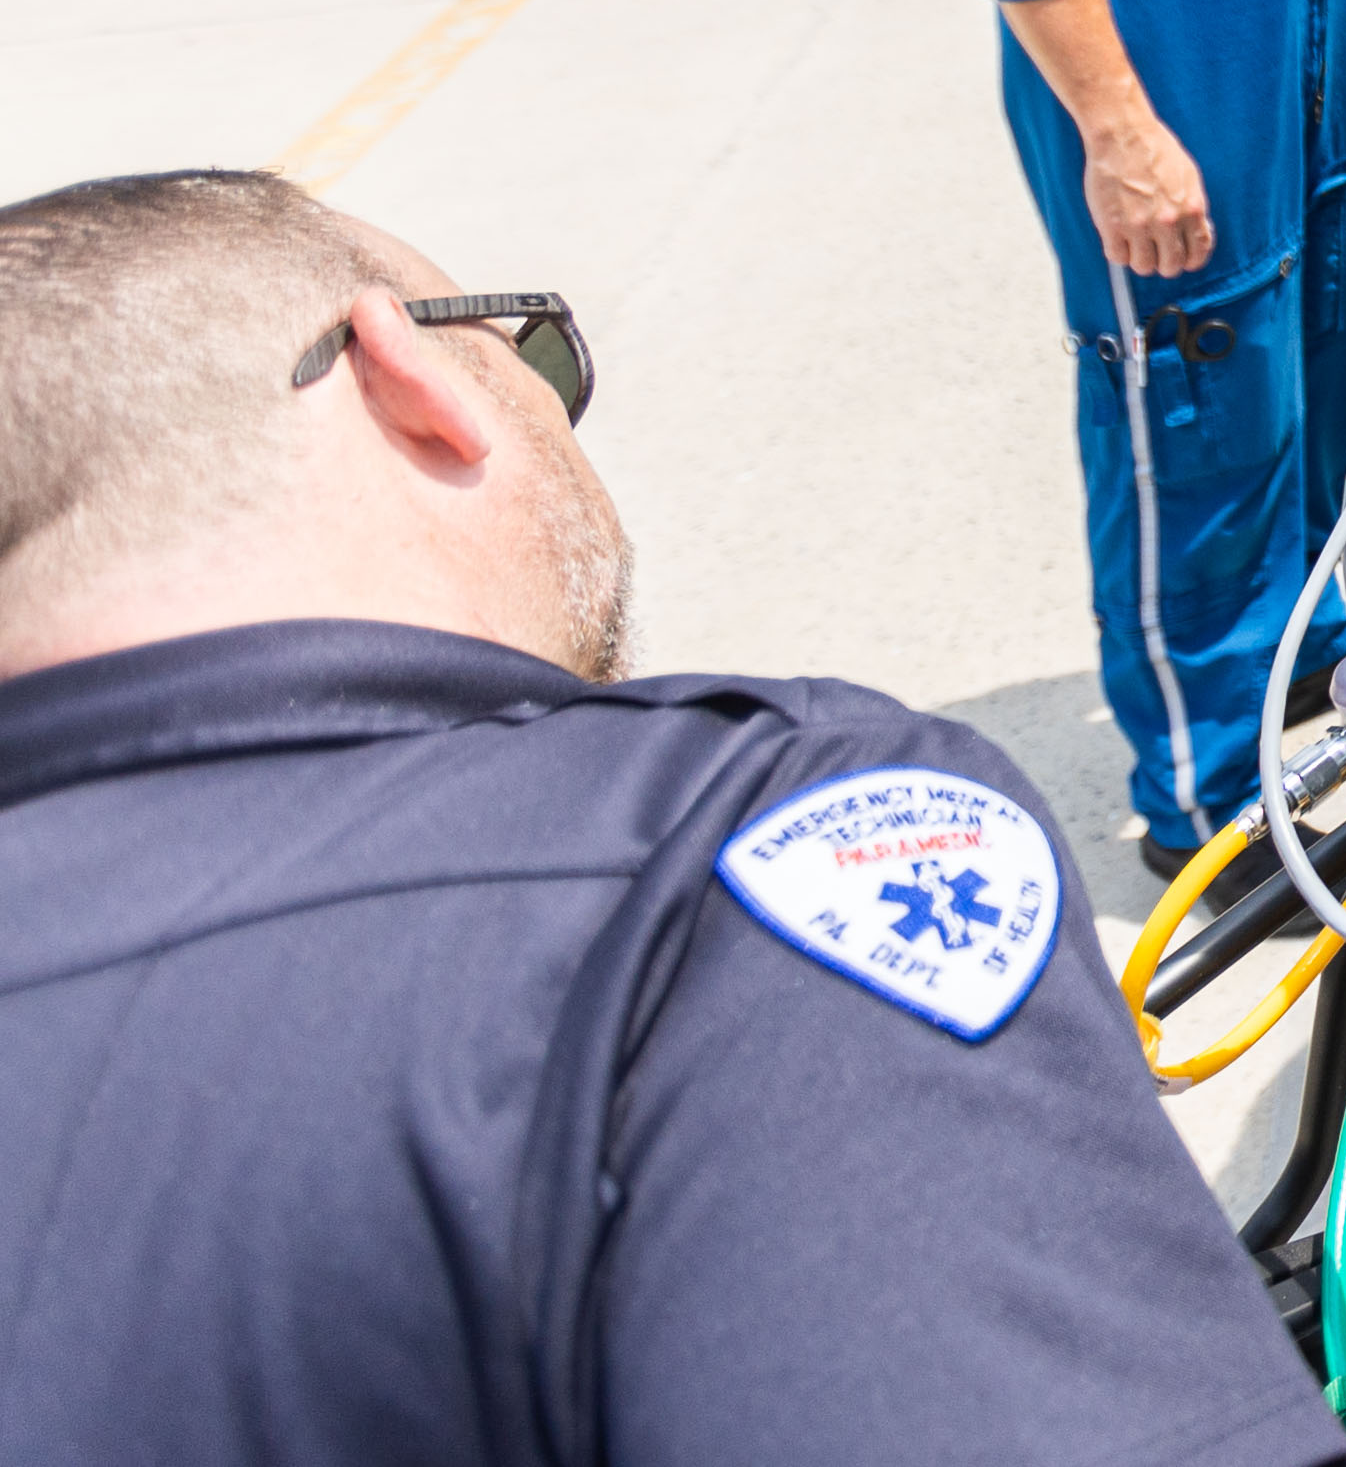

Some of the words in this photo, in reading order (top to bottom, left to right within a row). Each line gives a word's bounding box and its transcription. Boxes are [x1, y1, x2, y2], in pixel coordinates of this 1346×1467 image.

[750, 785, 913, 862] EMERGENCY
[834, 826, 993, 869] PARAMEDIC
[982, 944, 1011, 975] OF
